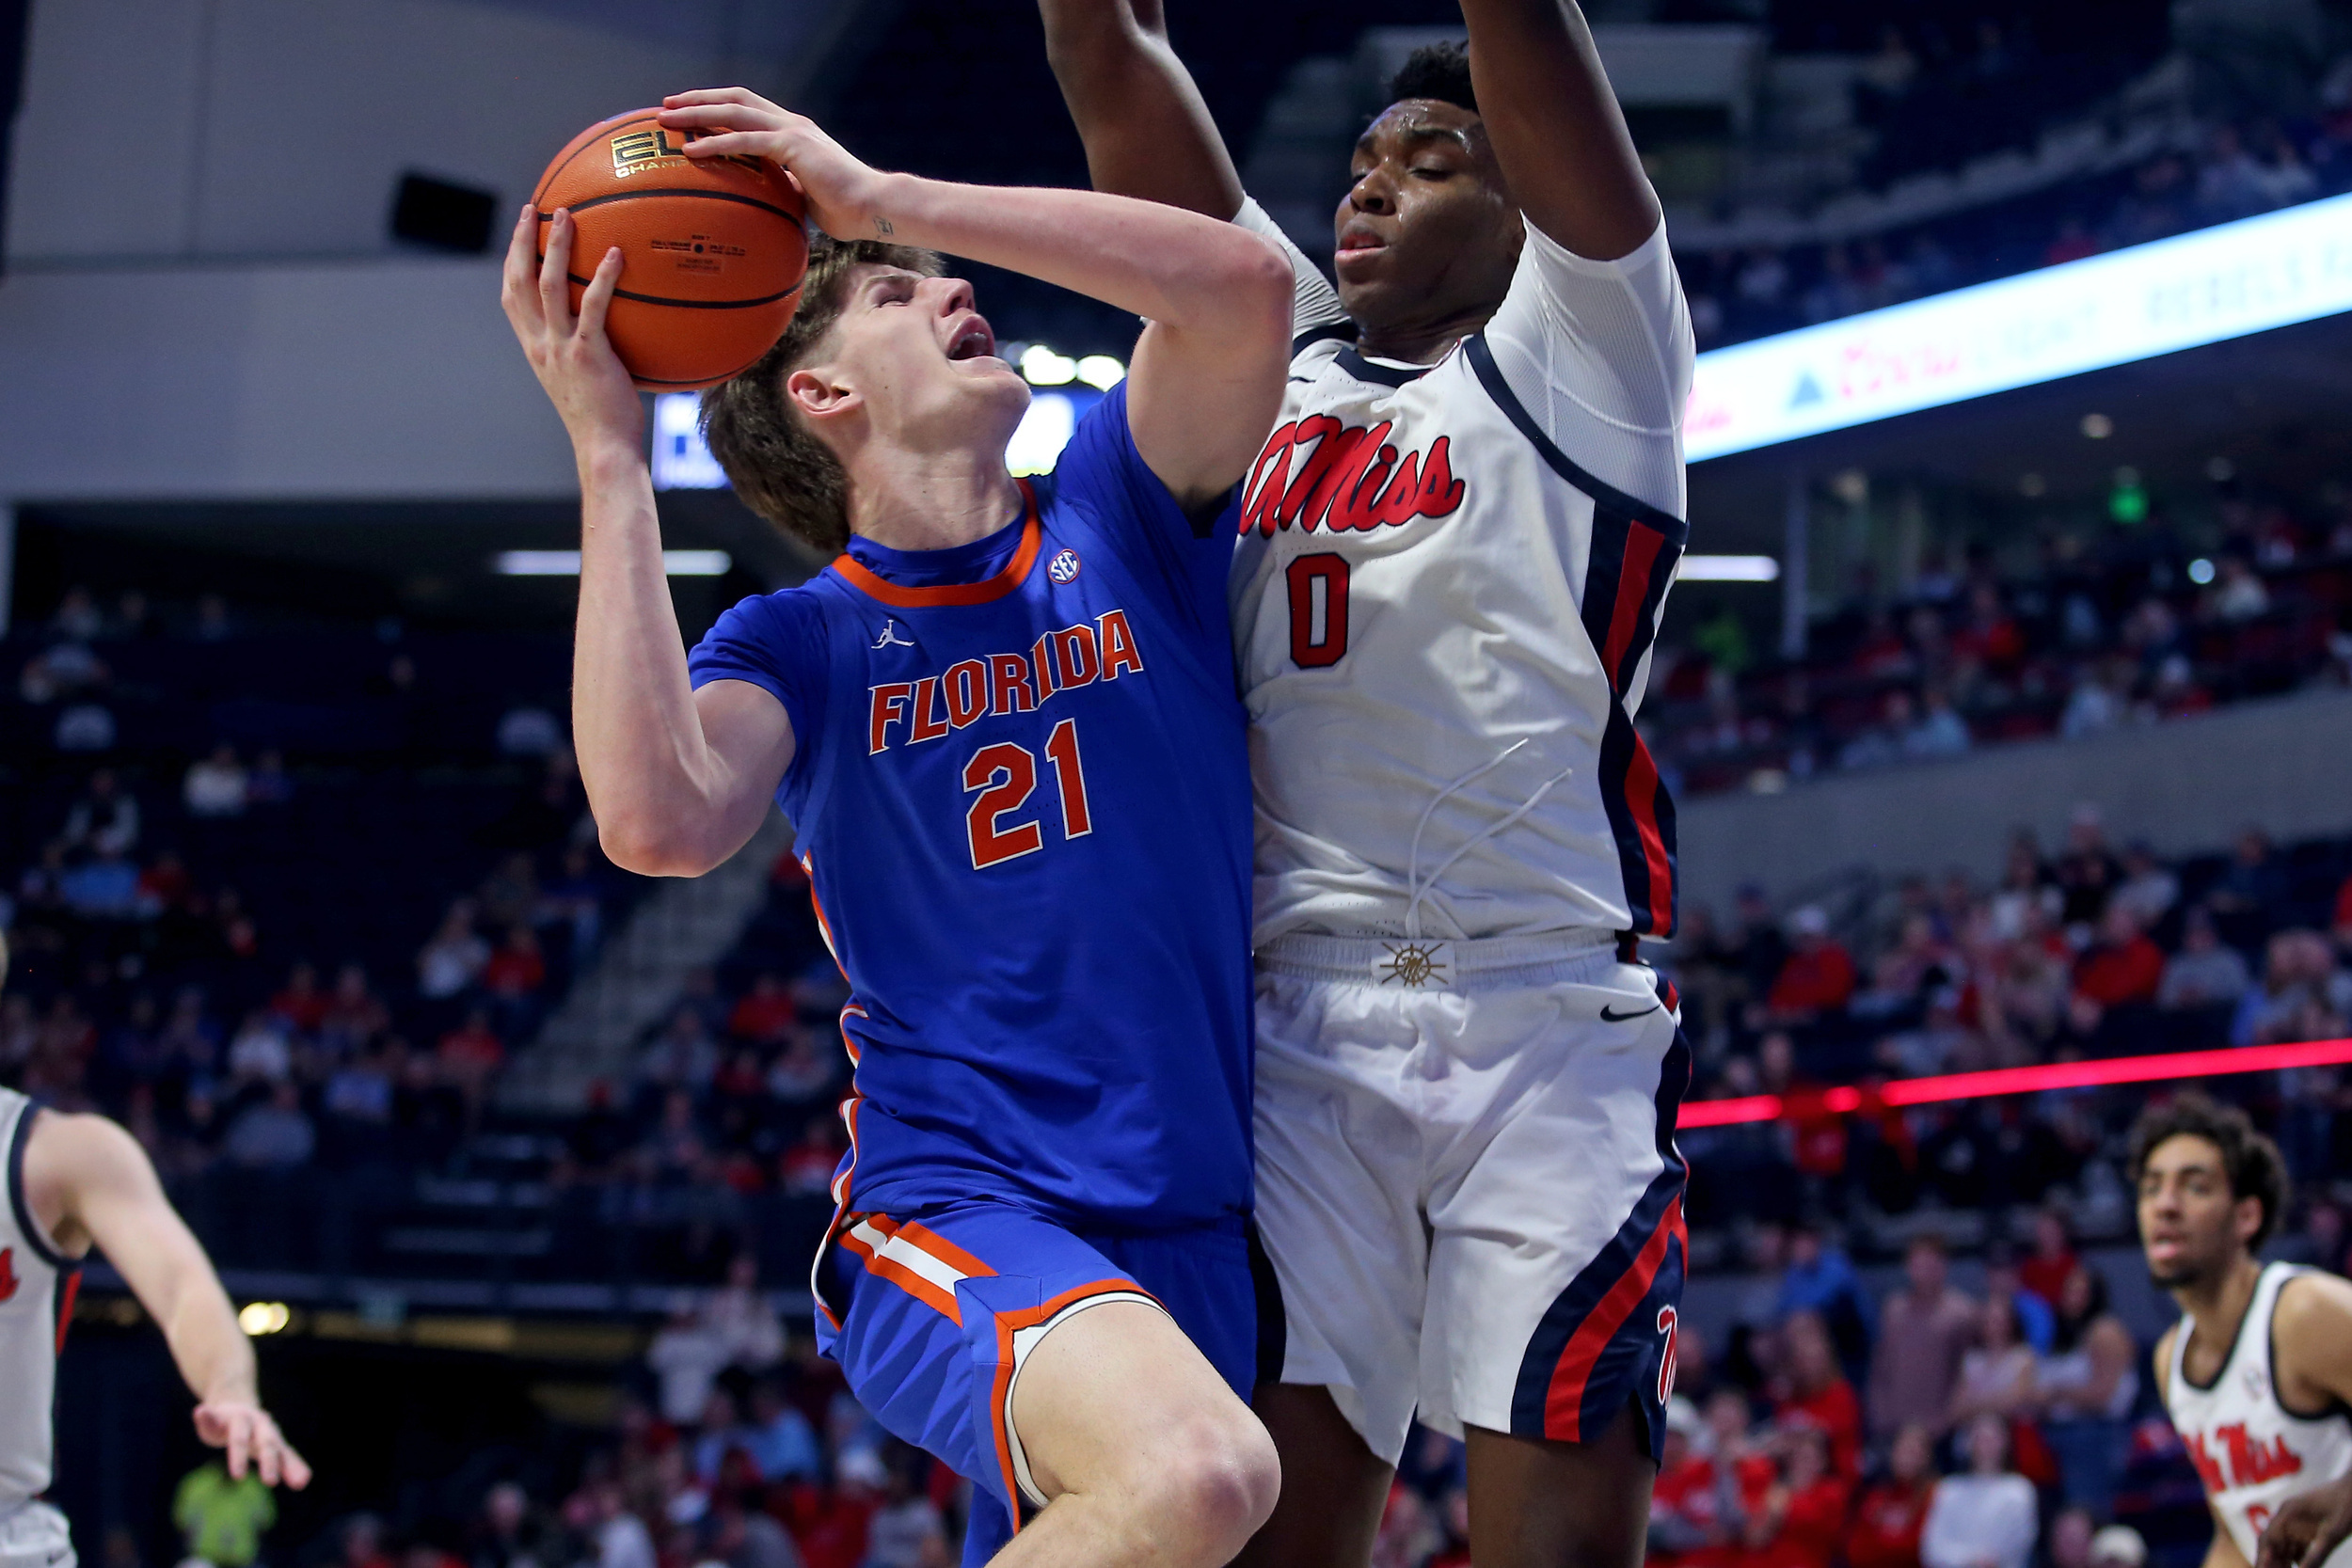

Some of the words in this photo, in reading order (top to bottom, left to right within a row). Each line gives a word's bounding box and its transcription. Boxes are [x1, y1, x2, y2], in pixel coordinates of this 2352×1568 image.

[1278, 412, 1465, 533] Miss
[1050, 551, 1077, 580] SEC
[1285, 551, 1351, 669] 0
[867, 609, 1144, 755] FLORIDA
[961, 717, 1092, 870] 21
